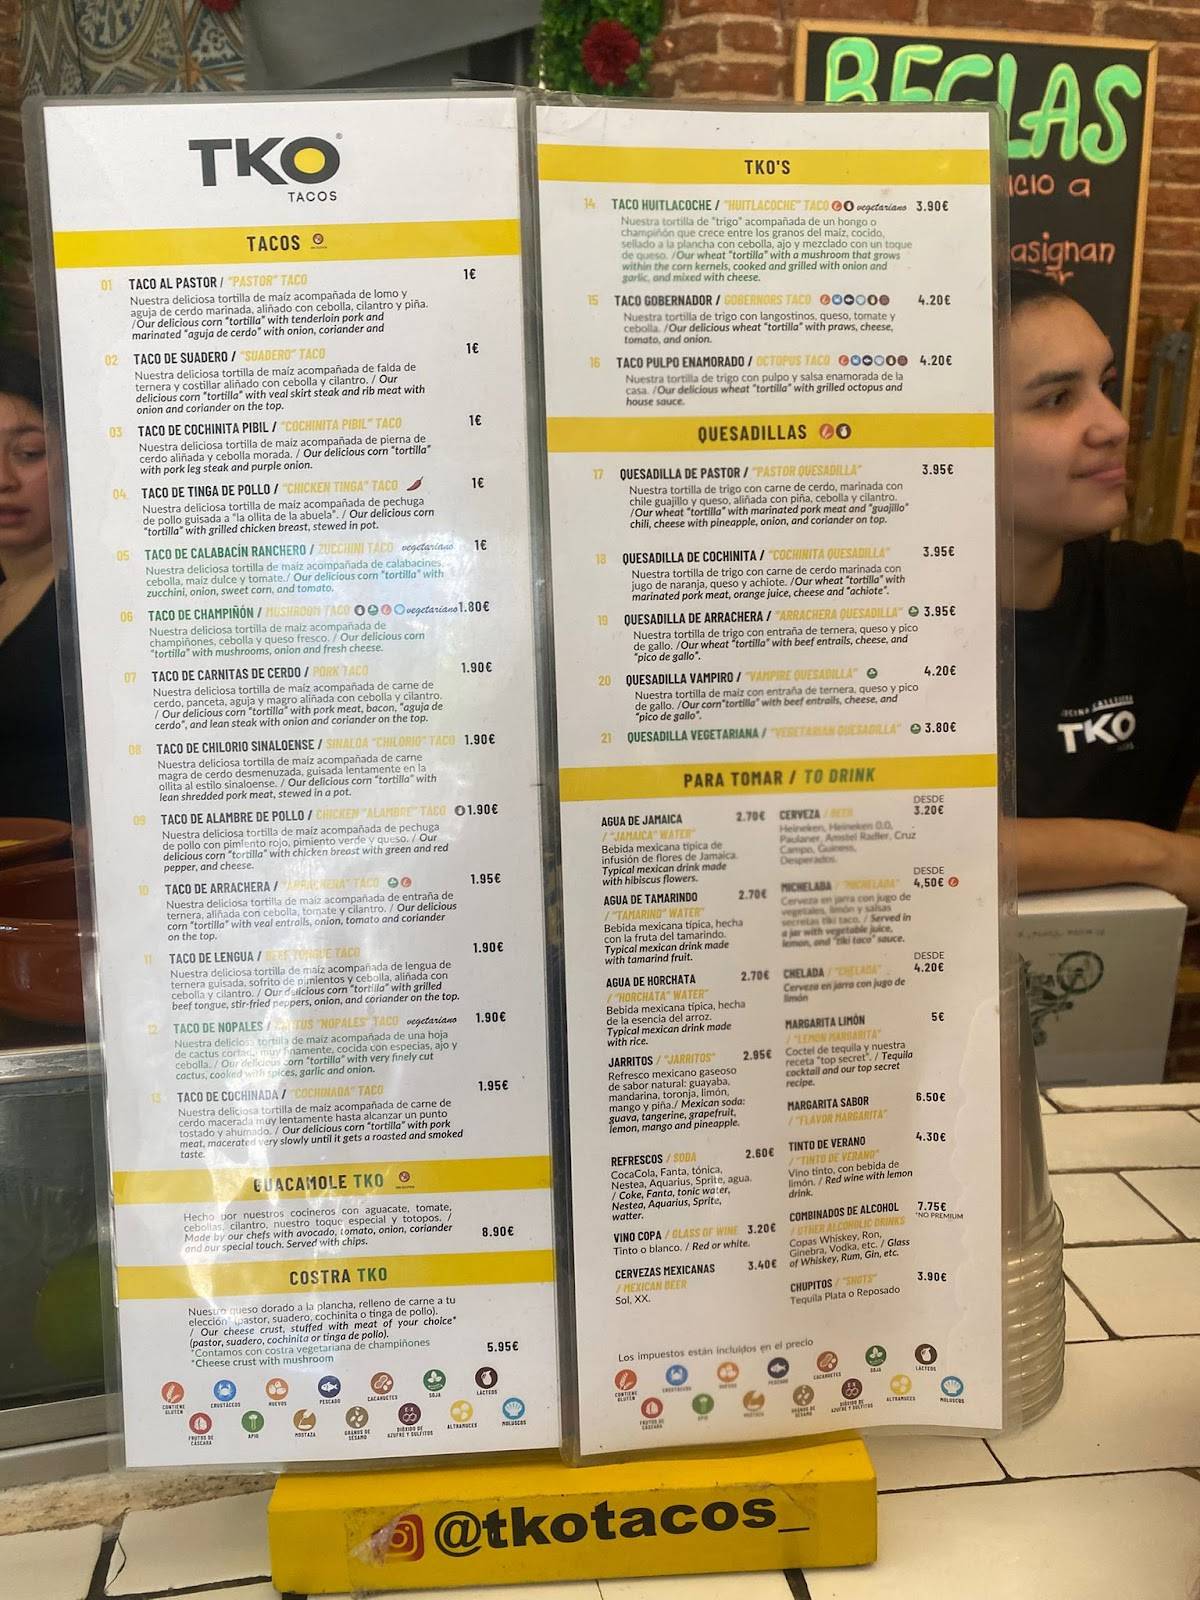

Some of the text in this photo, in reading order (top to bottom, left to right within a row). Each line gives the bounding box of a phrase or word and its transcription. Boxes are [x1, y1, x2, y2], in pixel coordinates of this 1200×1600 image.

[189, 137, 341, 187] TKO
[744, 158, 791, 176] TKO'S
[1068, 178, 1091, 198] a
[288, 190, 338, 203] TACOS
[611, 198, 711, 211] TACO HUITLACOCHE
[916, 200, 948, 212] 3.90€
[247, 234, 301, 252] TACOS
[1010, 231, 1116, 271] asignan
[464, 268, 476, 279] 1€
[128, 278, 156, 289] TACO
[160, 278, 172, 289] AL
[176, 276, 216, 288] PASTOR
[281, 274, 307, 286] TACO
[130, 295, 169, 305] Nuestra
[172, 294, 214, 304] deliciosa
[218, 293, 250, 303] tortilla
[253, 293, 265, 301] de
[359, 289, 371, 298] de
[374, 288, 398, 298] lomo
[401, 290, 406, 299] y
[614, 294, 713, 307] TACO GOBERNADOR
[918, 294, 950, 306] 4.20€
[624, 312, 661, 321] Nuestra
[665, 313, 696, 321] tortilla
[700, 312, 711, 320] de
[714, 311, 736, 322] trigo
[760, 310, 816, 322] langostinos,
[820, 313, 850, 321] queso,
[854, 312, 886, 320] tomate
[466, 342, 478, 354] 1€
[616, 355, 744, 369] TACO PULPO ENAMORADO
[920, 354, 952, 366] 4.20€
[469, 414, 481, 426] 1€
[698, 424, 808, 444] QUESADILLAS
[140, 460, 312, 475] with pork leg steak and purple onion.
[620, 467, 740, 480] QUESADILLA DE PASTOR
[922, 463, 953, 475] 3.95€
[472, 477, 484, 488] 1€
[141, 483, 270, 498] TACO DE TINGA DE POLLO
[474, 539, 486, 550] 1€
[923, 545, 954, 557] 3.95€
[148, 604, 253, 621] TACO DE CHAMPIÑÓN
[458, 601, 490, 614] 1.80€
[924, 605, 955, 616] 3.95€
[461, 661, 492, 673] 1.90€
[924, 665, 956, 676] 4.20€
[626, 672, 733, 686] QUESADILLA VAMPIRO
[925, 721, 956, 733] 3.80€
[1057, 710, 1136, 753] TKO
[464, 733, 495, 745] 1.90€
[627, 728, 758, 743] QUESADILLA VEGETARIANA
[156, 739, 314, 754] TACO DE CHILORIO SINALOENSE
[683, 772, 724, 789] PARA
[731, 770, 784, 787] TOMAR
[804, 768, 823, 785] TO
[829, 766, 876, 784] DRINK
[913, 795, 943, 803] DESDE
[467, 803, 498, 816] 1.90€
[914, 804, 943, 815] 3.20€
[601, 813, 682, 826] AGUA DE JAMAICA
[736, 811, 764, 821] 2.70€
[470, 873, 500, 884] 1.95€
[914, 877, 943, 888] 4,50€
[164, 881, 270, 894] TACO DE ARRACHERA
[738, 889, 766, 899] 2.70€
[473, 941, 503, 953] 1.90€
[914, 962, 944, 972] 4.20€
[741, 970, 768, 981] 2.70€
[476, 1011, 505, 1023] 1.90€
[931, 1011, 944, 1021] 5€
[173, 1021, 262, 1033] TACO DE NOPALES
[743, 1049, 771, 1060] 2.95€
[608, 1055, 652, 1067] JARRITOS
[478, 1079, 508, 1091] 1.95€
[916, 1091, 945, 1102] 6.50€
[915, 1131, 945, 1142] 4.30€
[788, 1136, 865, 1151] TINTO DE VERANO
[745, 1147, 774, 1158] 2.60€
[611, 1153, 662, 1166] REFRESCOS
[254, 1172, 385, 1193] GUACAMOLE TKO
[789, 1202, 898, 1221] COMBINADOS DE ALCOHOL
[917, 1200, 946, 1214] 7.75€
[931, 1213, 963, 1221] PREMIUM
[482, 1225, 514, 1237] 8.90€
[747, 1222, 775, 1234] 3.20€
[748, 1259, 776, 1270] 3.40€
[289, 1266, 388, 1286] COSTRA TKO
[615, 1264, 714, 1279] CERVEZAS MEXICANAS
[917, 1270, 946, 1282] 3.90€
[790, 1278, 833, 1291] CHUPITOS
[487, 1341, 518, 1352] 5.95€
[618, 1353, 634, 1362] Los
[638, 1350, 684, 1360] impuestos
[774, 1341, 782, 1349] el
[785, 1337, 813, 1351] precio
[434, 1498, 810, 1558] @tkotacos_
